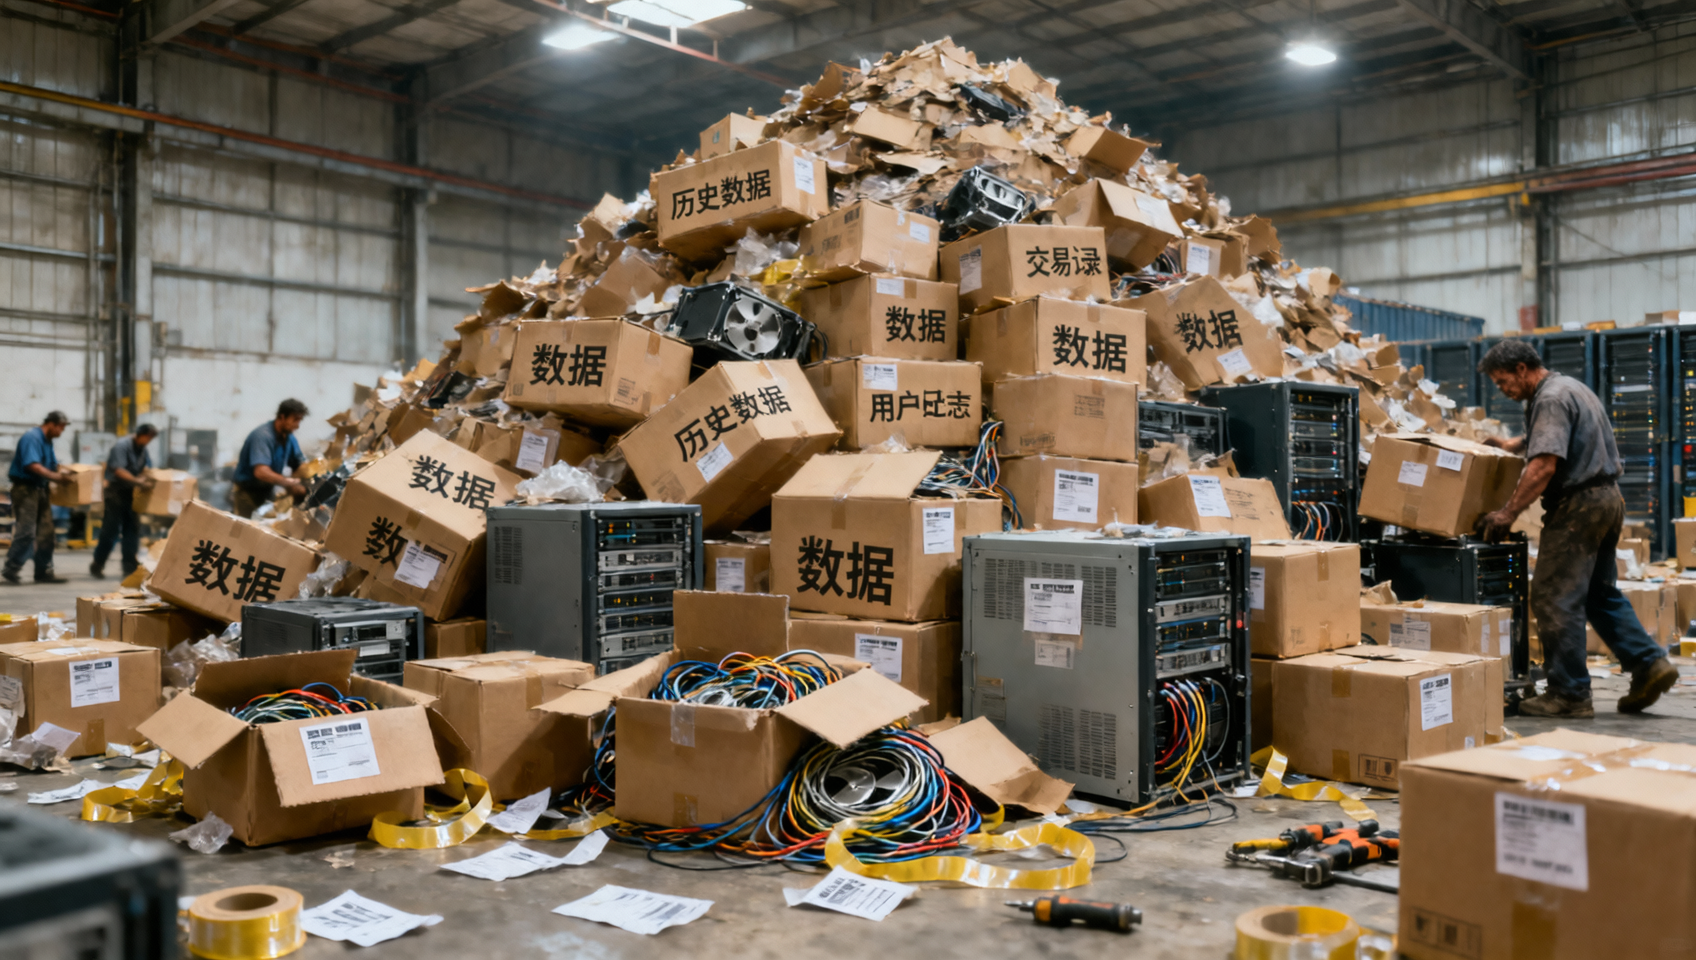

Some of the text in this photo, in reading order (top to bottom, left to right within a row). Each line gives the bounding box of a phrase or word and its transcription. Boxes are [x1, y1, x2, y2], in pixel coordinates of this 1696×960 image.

[671, 169, 771, 221] 历史数据
[885, 305, 946, 344] 数据
[1053, 324, 1127, 373] 数据
[1175, 309, 1243, 355] 数据
[529, 343, 607, 387] 数据
[674, 384, 792, 462] 历史数据
[409, 455, 496, 512] 数据
[185, 539, 286, 602] 数据
[797, 536, 894, 606] 数据
